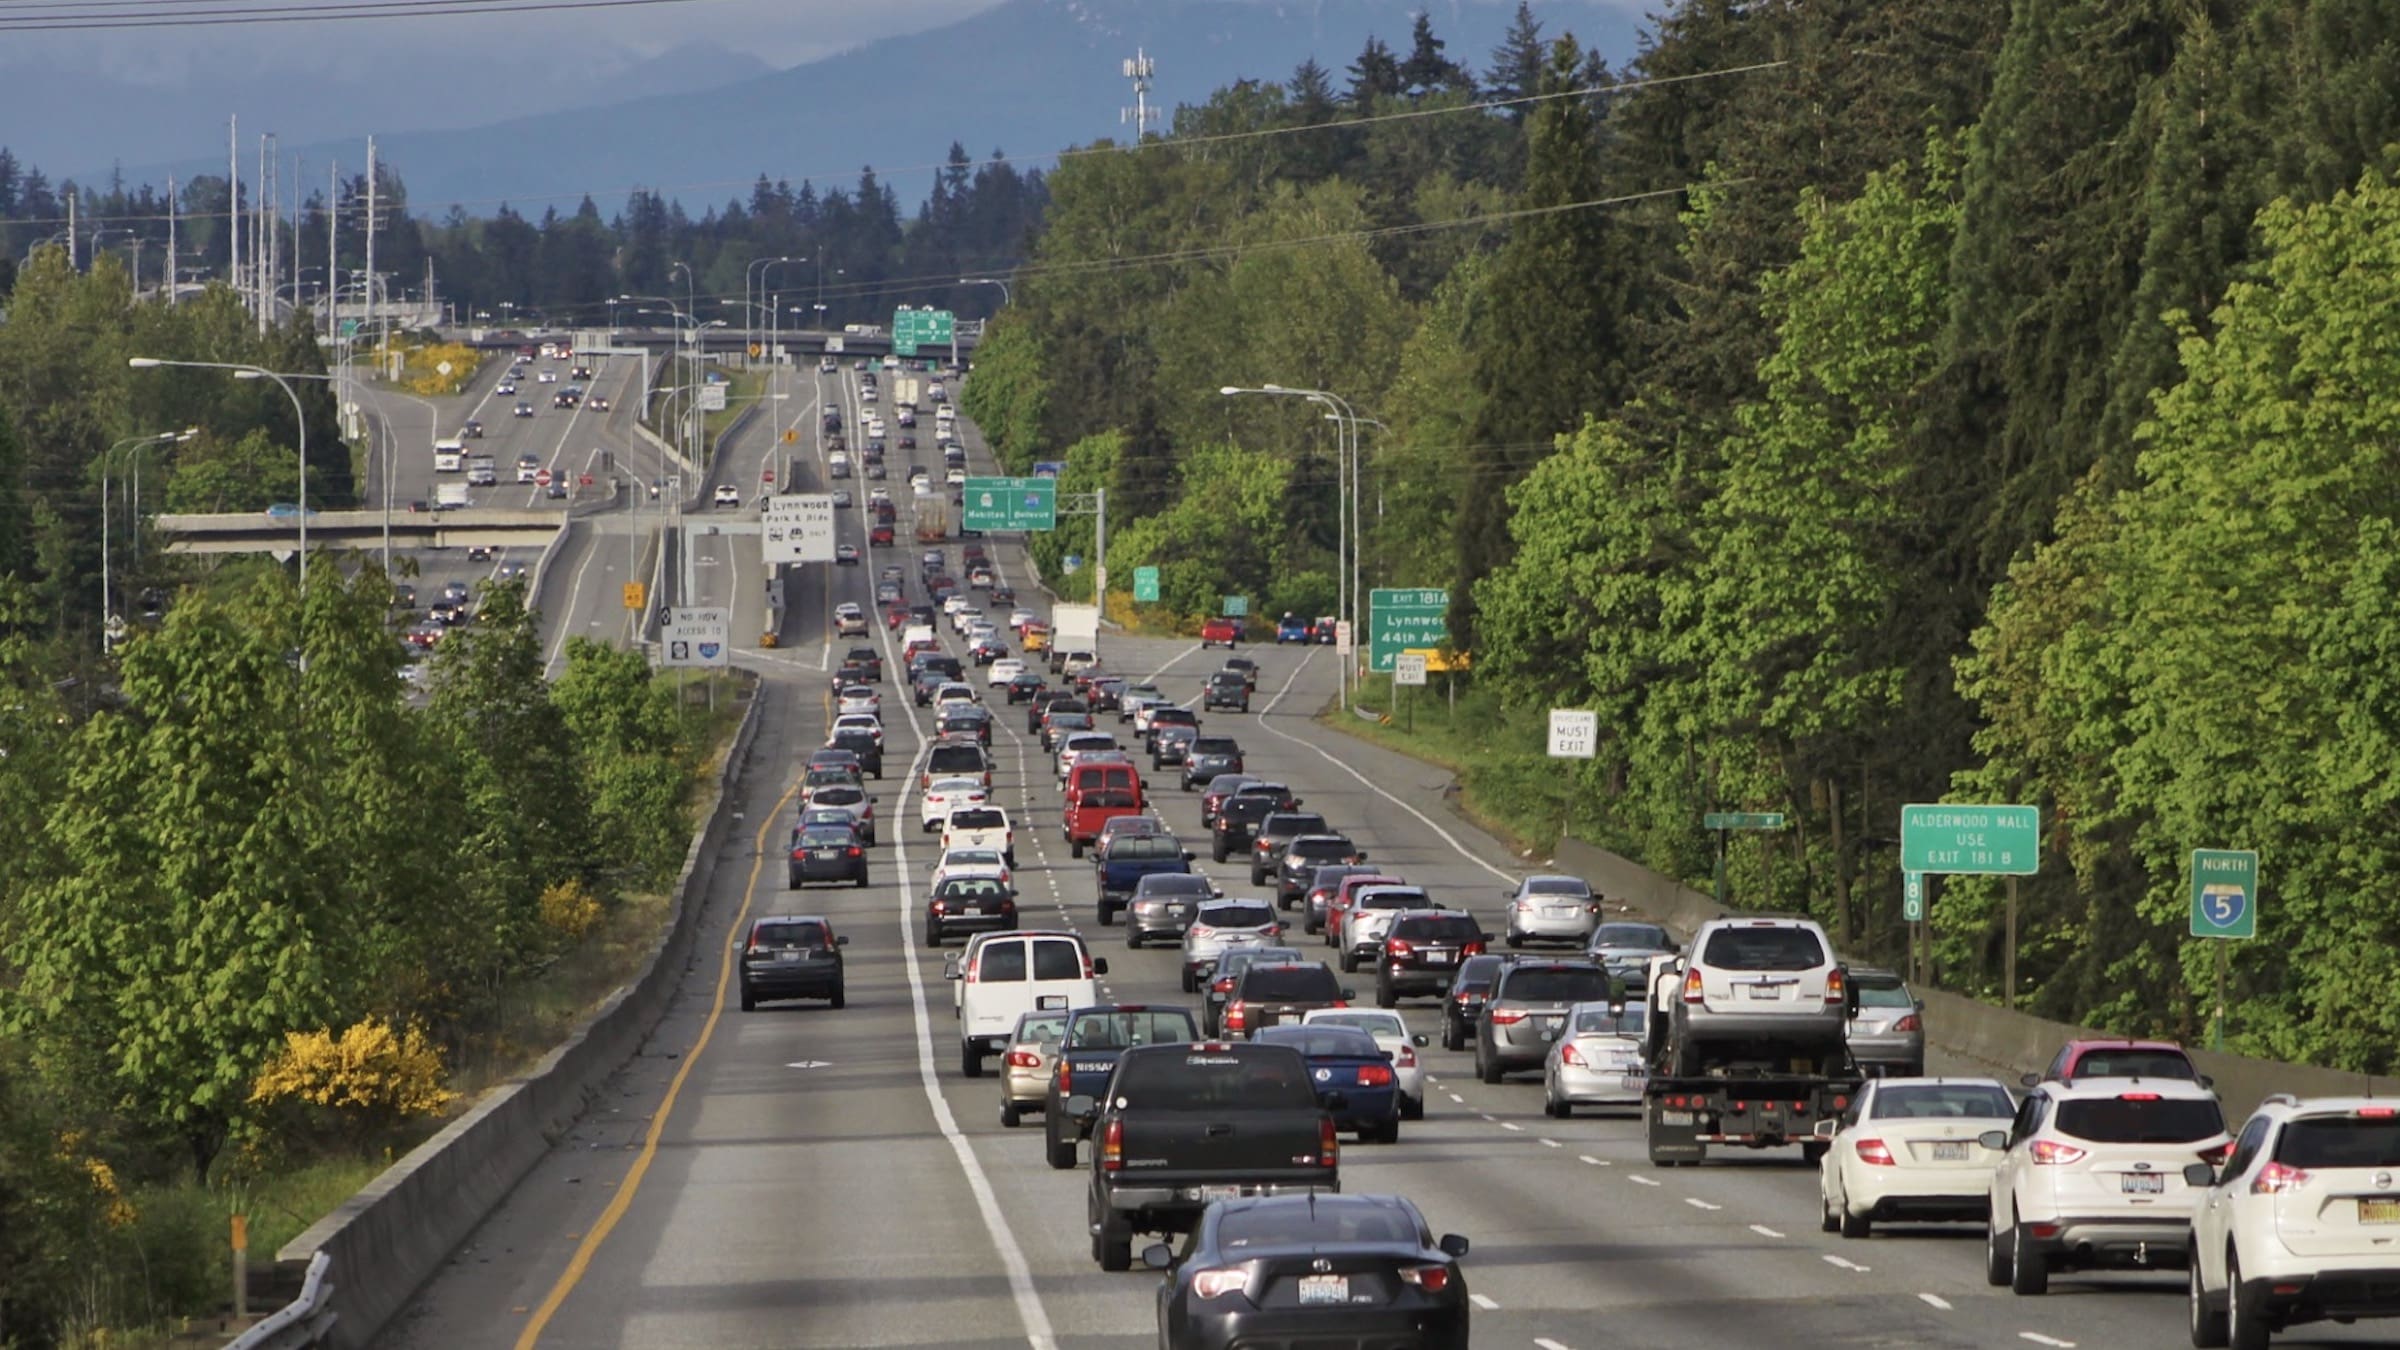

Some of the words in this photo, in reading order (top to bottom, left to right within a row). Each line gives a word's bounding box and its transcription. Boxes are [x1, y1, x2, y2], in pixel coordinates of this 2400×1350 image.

[773, 502, 828, 511] Lynnwood
[1392, 594, 1413, 604] EXIT
[1420, 592, 1449, 604] 181A
[1381, 632, 1416, 643] 44th
[1556, 726, 1589, 737] MUST
[1559, 740, 1585, 752] EXIT
[1911, 814, 1988, 828] ALDERWOOD
[1997, 815, 2031, 829] MALL
[1956, 833, 1986, 847] USE
[1927, 850, 1960, 864] EXIT
[1972, 851, 1993, 865] 181
[2001, 851, 2013, 865] B
[2202, 858, 2248, 872] NORTH
[2215, 896, 2231, 919] 5
